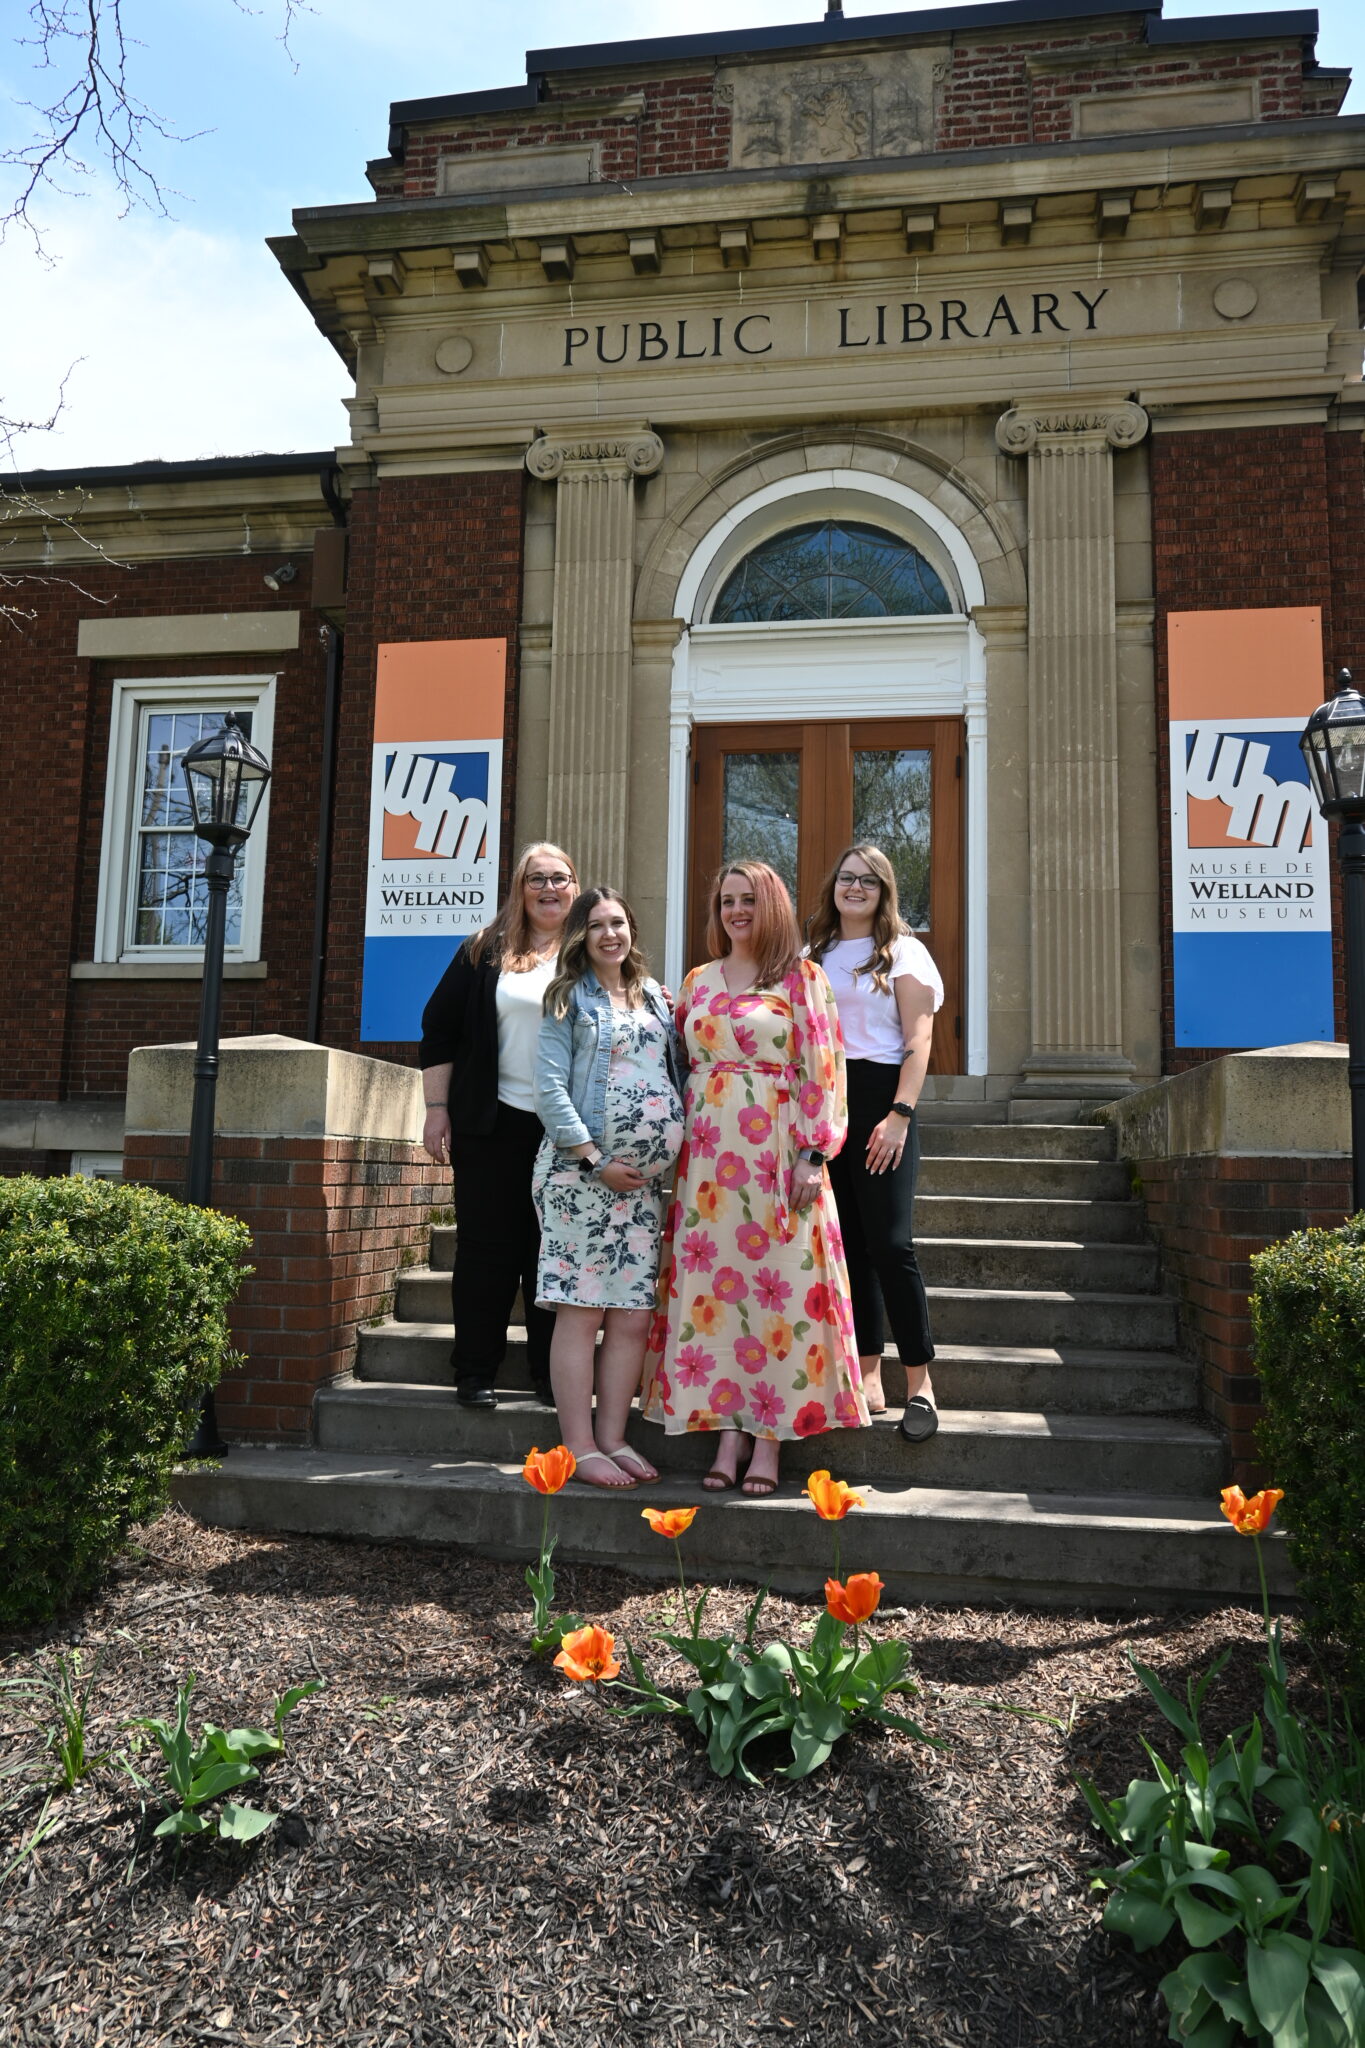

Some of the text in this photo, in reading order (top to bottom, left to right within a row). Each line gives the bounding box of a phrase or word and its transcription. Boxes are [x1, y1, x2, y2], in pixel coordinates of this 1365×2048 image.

[562, 288, 1109, 367] PUBLIC LIBRARY
[1189, 861, 1313, 875] MUSÉE DE
[381, 871, 485, 884] MUSÉE DE
[1189, 881, 1314, 899] WELLAND
[381, 890, 485, 906] WELLAND
[380, 913, 483, 925] MUSEUM
[1190, 907, 1314, 919] MUSEUM
